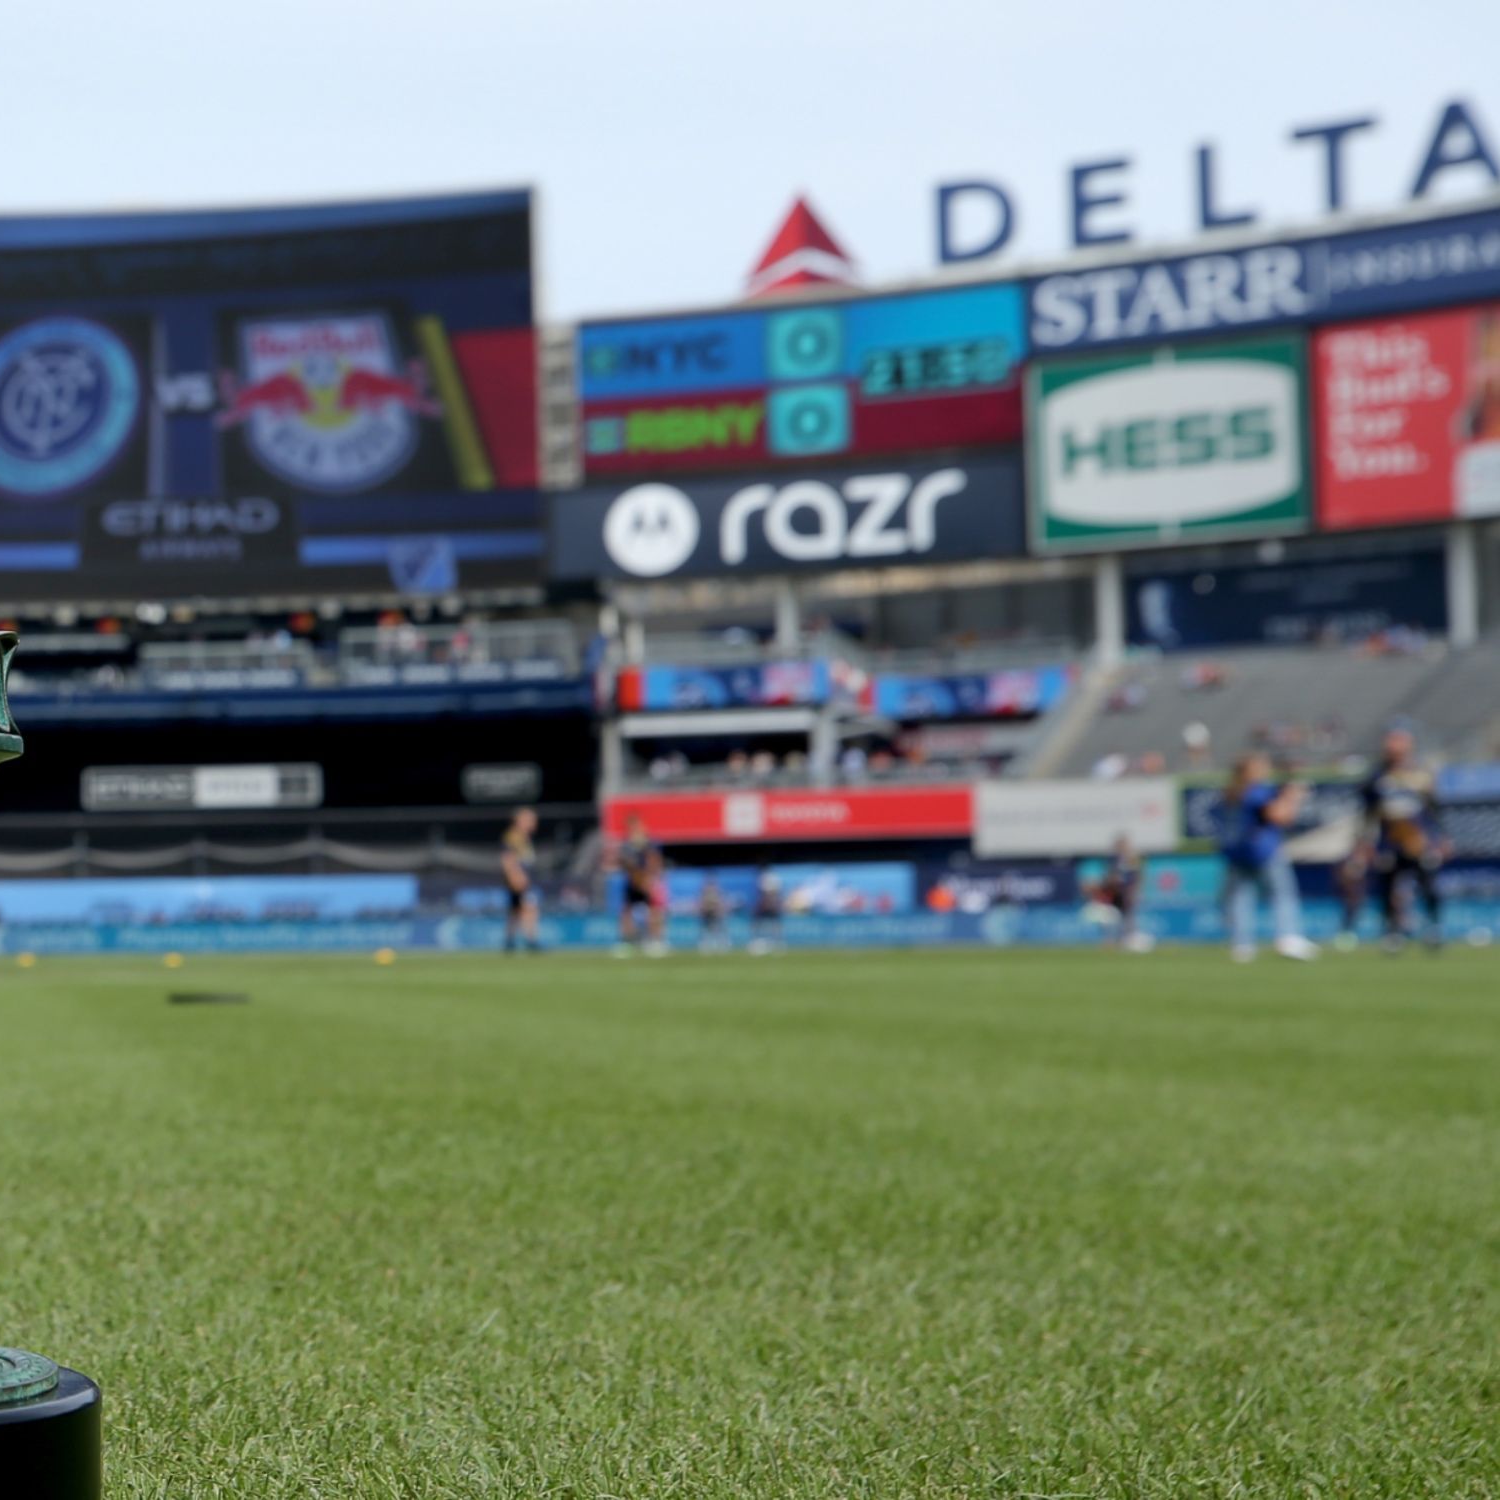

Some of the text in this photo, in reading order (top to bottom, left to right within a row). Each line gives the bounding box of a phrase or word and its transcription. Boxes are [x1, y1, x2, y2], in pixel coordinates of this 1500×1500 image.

[934, 98, 1500, 266] DELTA
[1031, 248, 1314, 347] STARR
[1060, 406, 1276, 477] HESS
[719, 468, 967, 566] razr
